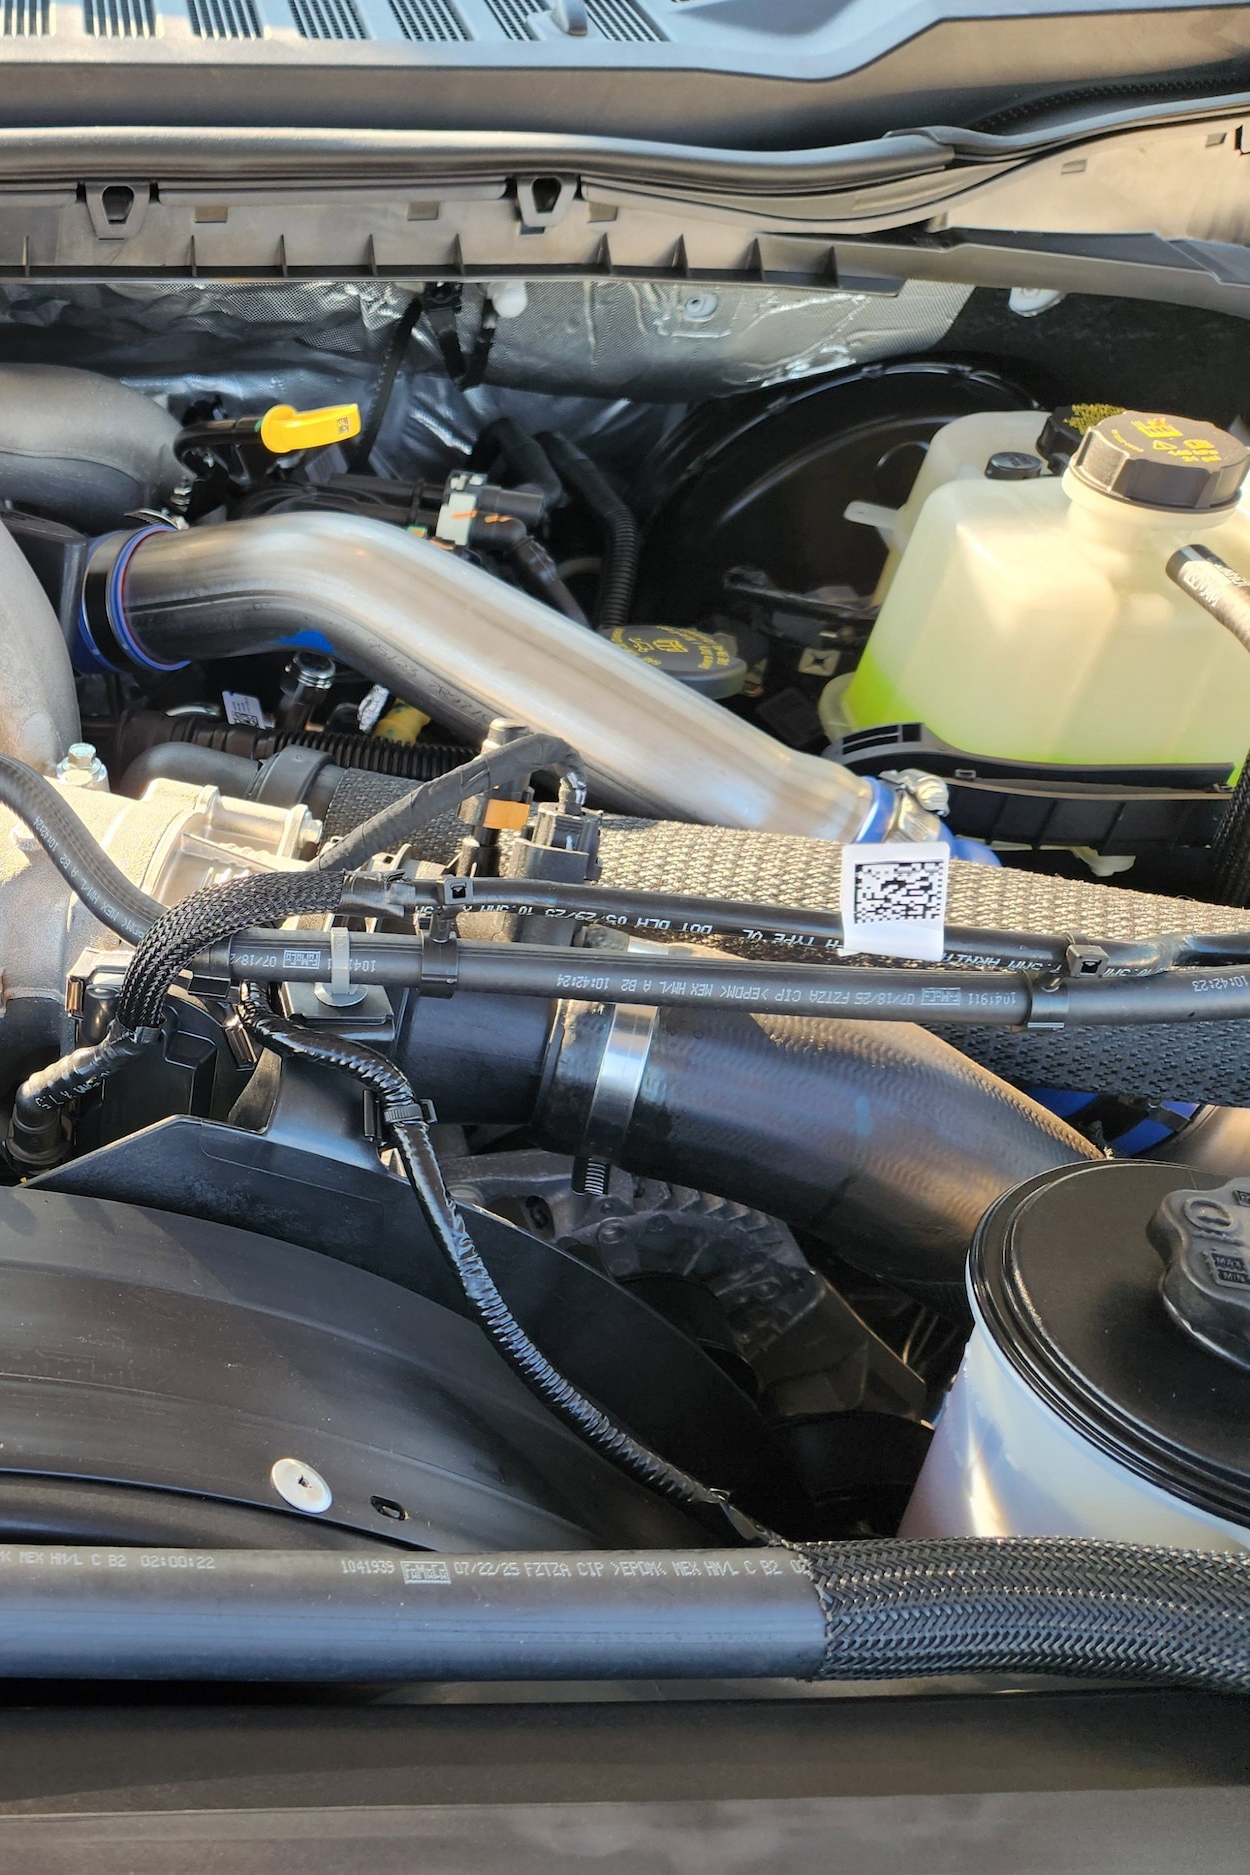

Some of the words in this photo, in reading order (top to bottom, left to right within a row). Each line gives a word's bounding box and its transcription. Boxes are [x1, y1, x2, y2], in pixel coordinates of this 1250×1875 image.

[635, 917, 671, 930] DLH
[681, 922, 713, 935] DOT
[774, 932, 815, 947] TYPE
[230, 952, 277, 968] 07/18/2
[557, 974, 610, 990] 10:42:24
[622, 978, 637, 992] B2
[643, 979, 652, 992] A
[1192, 975, 1249, 992] 10:42:23
[691, 983, 714, 997] MEX
[774, 988, 801, 1003] CIP
[19, 1552, 44, 1565] MEX
[92, 1554, 101, 1566] C
[108, 1554, 127, 1568] B2
[140, 1555, 216, 1569] 02:00:22
[342, 1560, 395, 1574] 1041939
[453, 1561, 520, 1577] 07/22/25
[576, 1561, 604, 1577] CIP
[671, 1561, 701, 1576] MEX
[743, 1560, 756, 1576] C
[759, 1560, 783, 1576] B2
